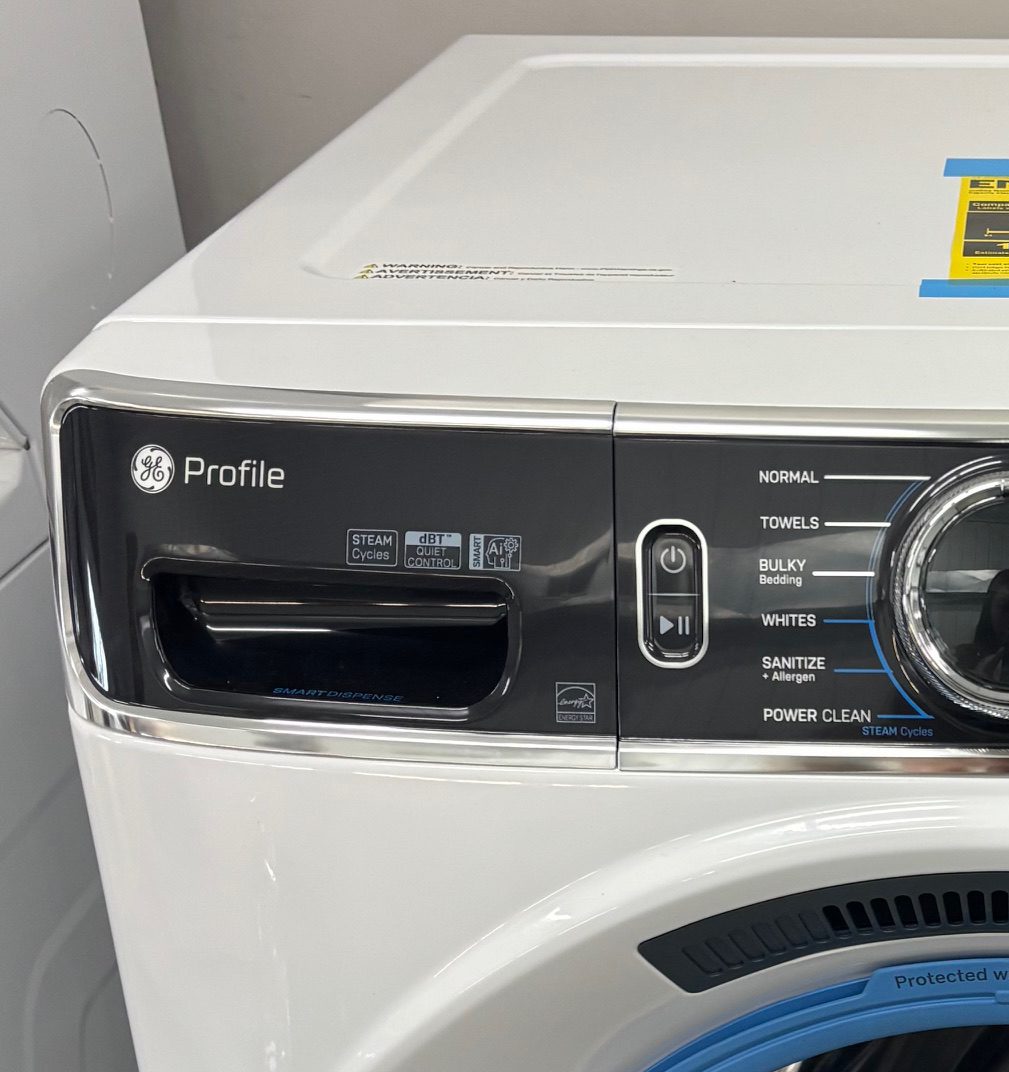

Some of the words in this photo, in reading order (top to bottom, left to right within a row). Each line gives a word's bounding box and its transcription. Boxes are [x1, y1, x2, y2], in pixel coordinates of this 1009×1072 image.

[184, 457, 285, 489] Profile
[759, 470, 820, 484] NORMAL
[760, 516, 820, 530] TOWELS
[352, 534, 392, 546] STEAM
[352, 549, 390, 561] Cycles
[416, 547, 446, 556] QUIET
[473, 536, 481, 568] SMART
[407, 558, 457, 568] CONTROL
[759, 558, 806, 572] BULKY
[759, 574, 802, 586] Bedding
[761, 613, 816, 627] WHITES
[762, 656, 826, 670] SANITIZE
[771, 671, 816, 683] Allergen
[763, 708, 818, 722] POWER
[822, 708, 871, 723] CLEAN
[862, 726, 897, 737] STEAM
[900, 726, 934, 738] Cycles
[895, 968, 987, 989] Protected
